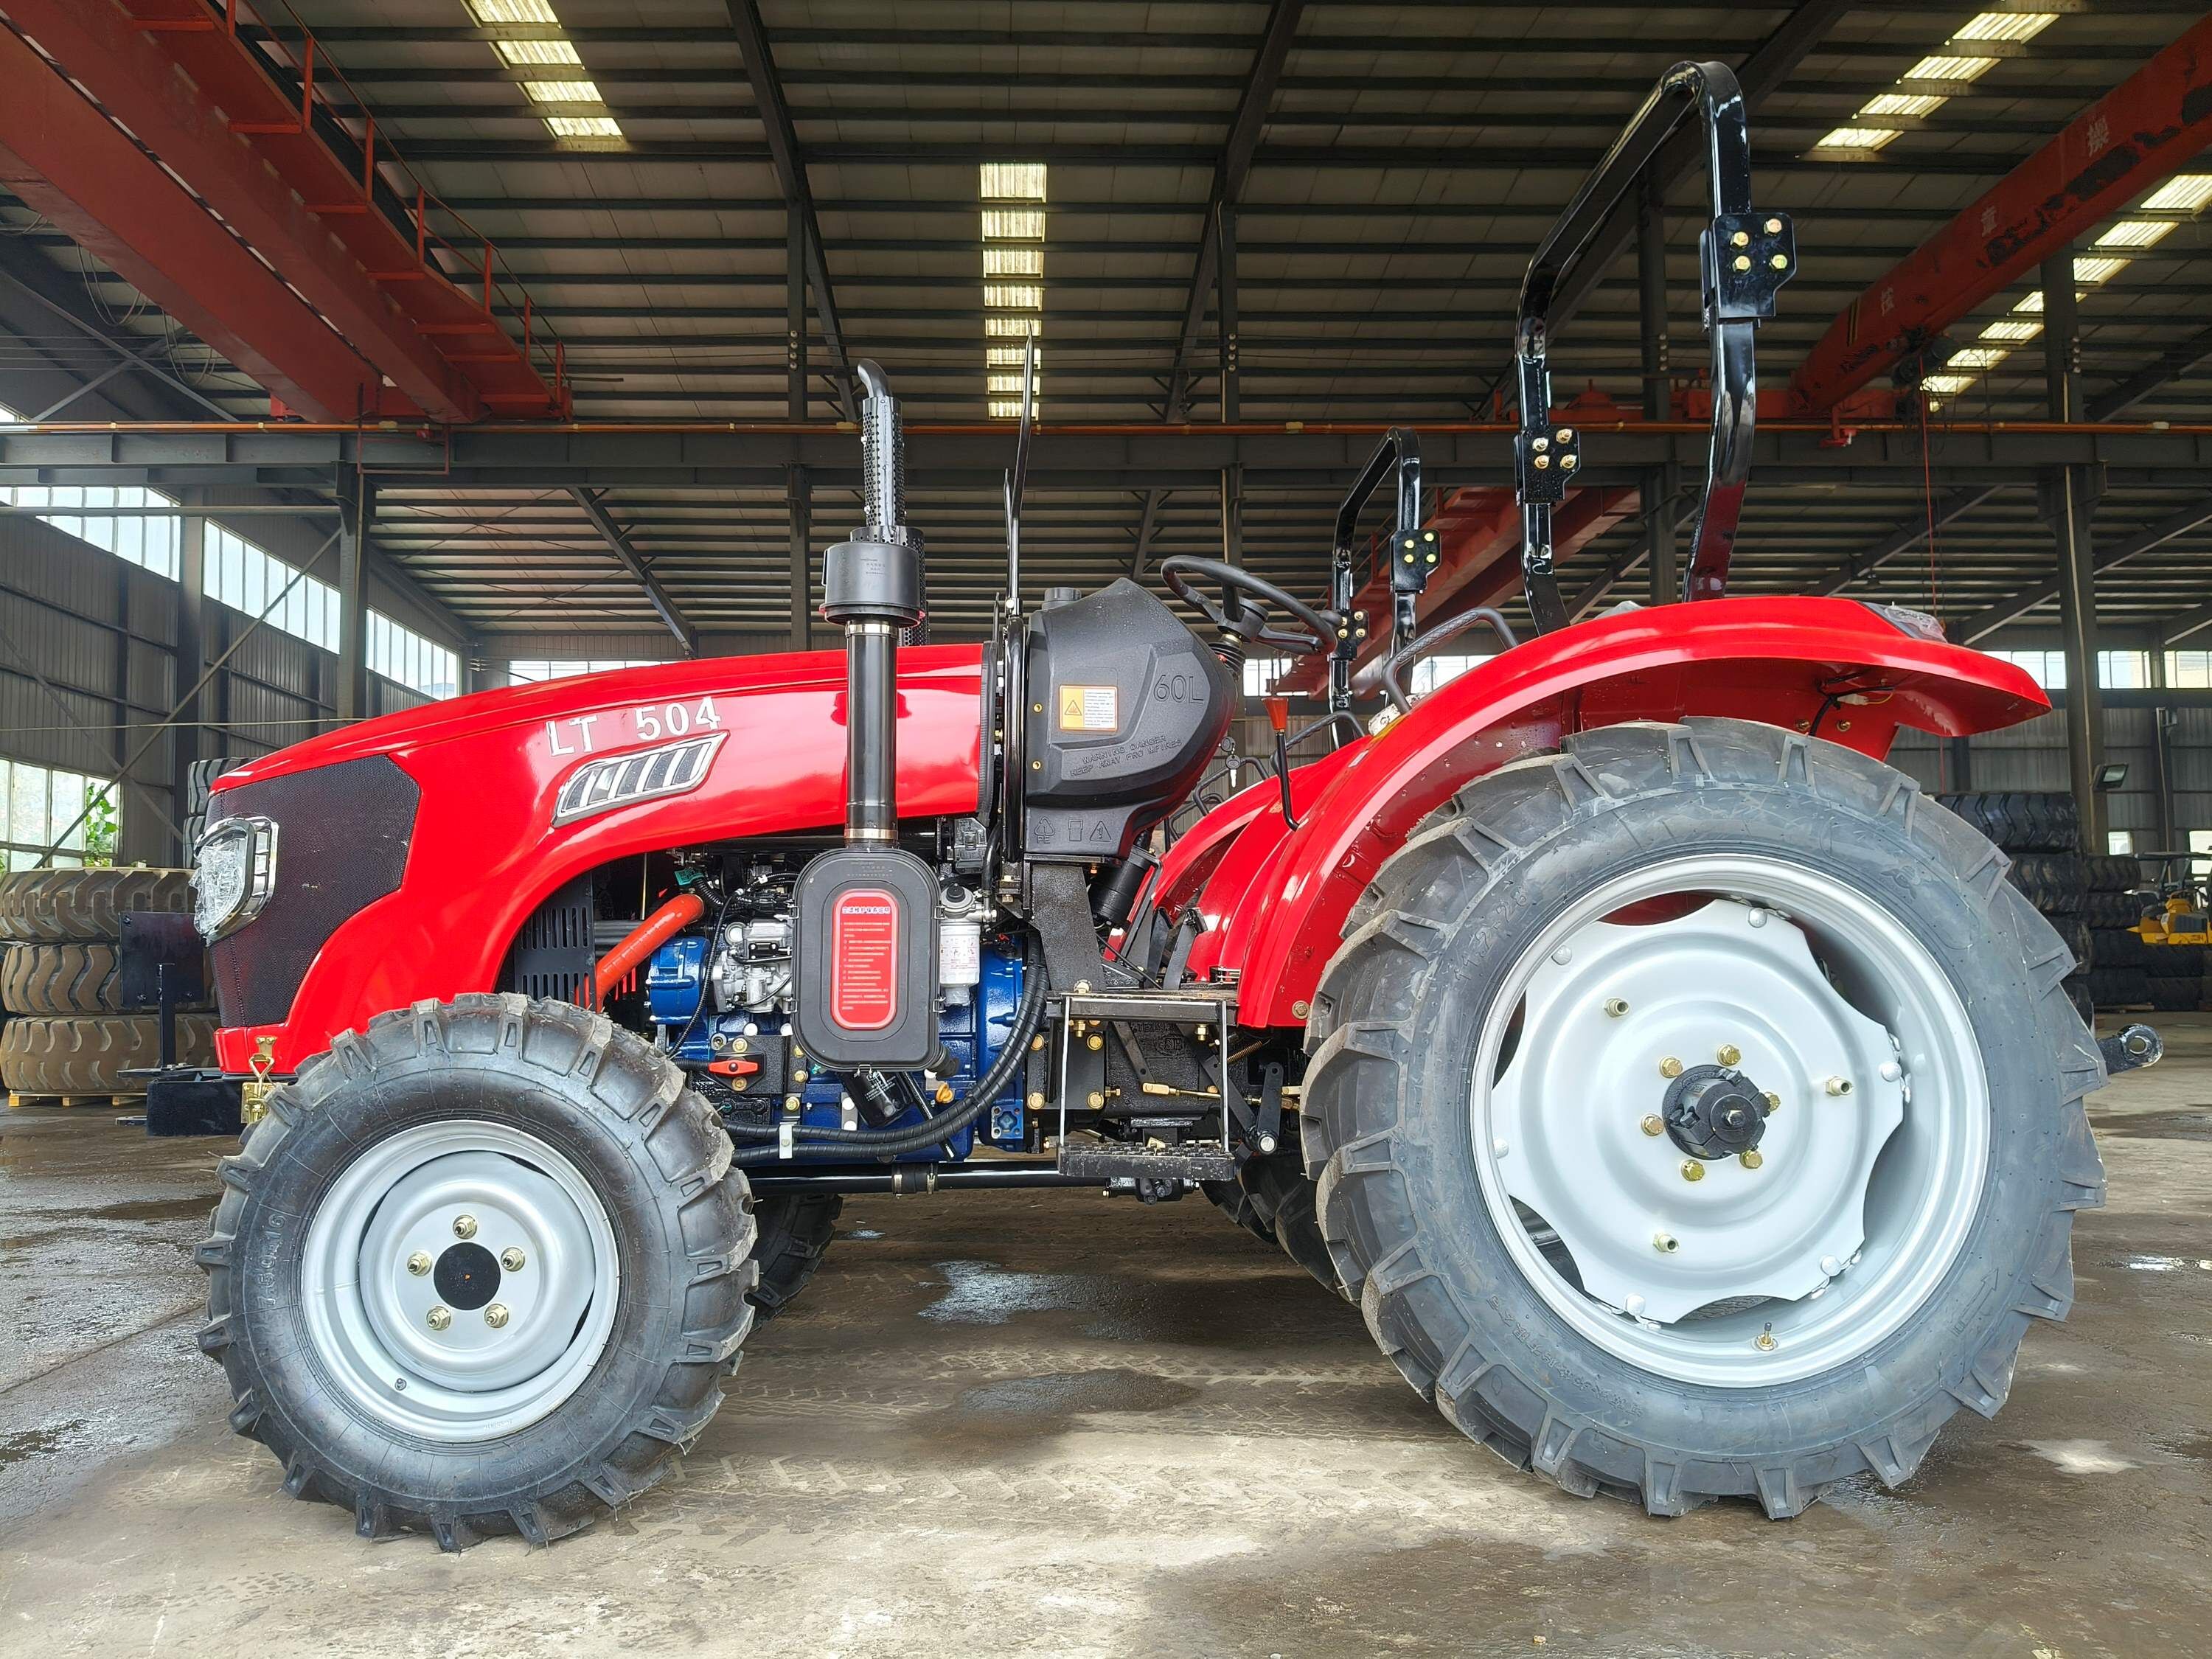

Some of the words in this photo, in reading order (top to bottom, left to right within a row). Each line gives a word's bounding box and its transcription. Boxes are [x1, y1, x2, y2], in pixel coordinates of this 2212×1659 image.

[1153, 674, 1204, 704] 60L
[545, 715, 598, 757] LT
[634, 696, 722, 740] 504
[1129, 735, 1166, 751] DANGER
[1037, 835, 1051, 844] PE
